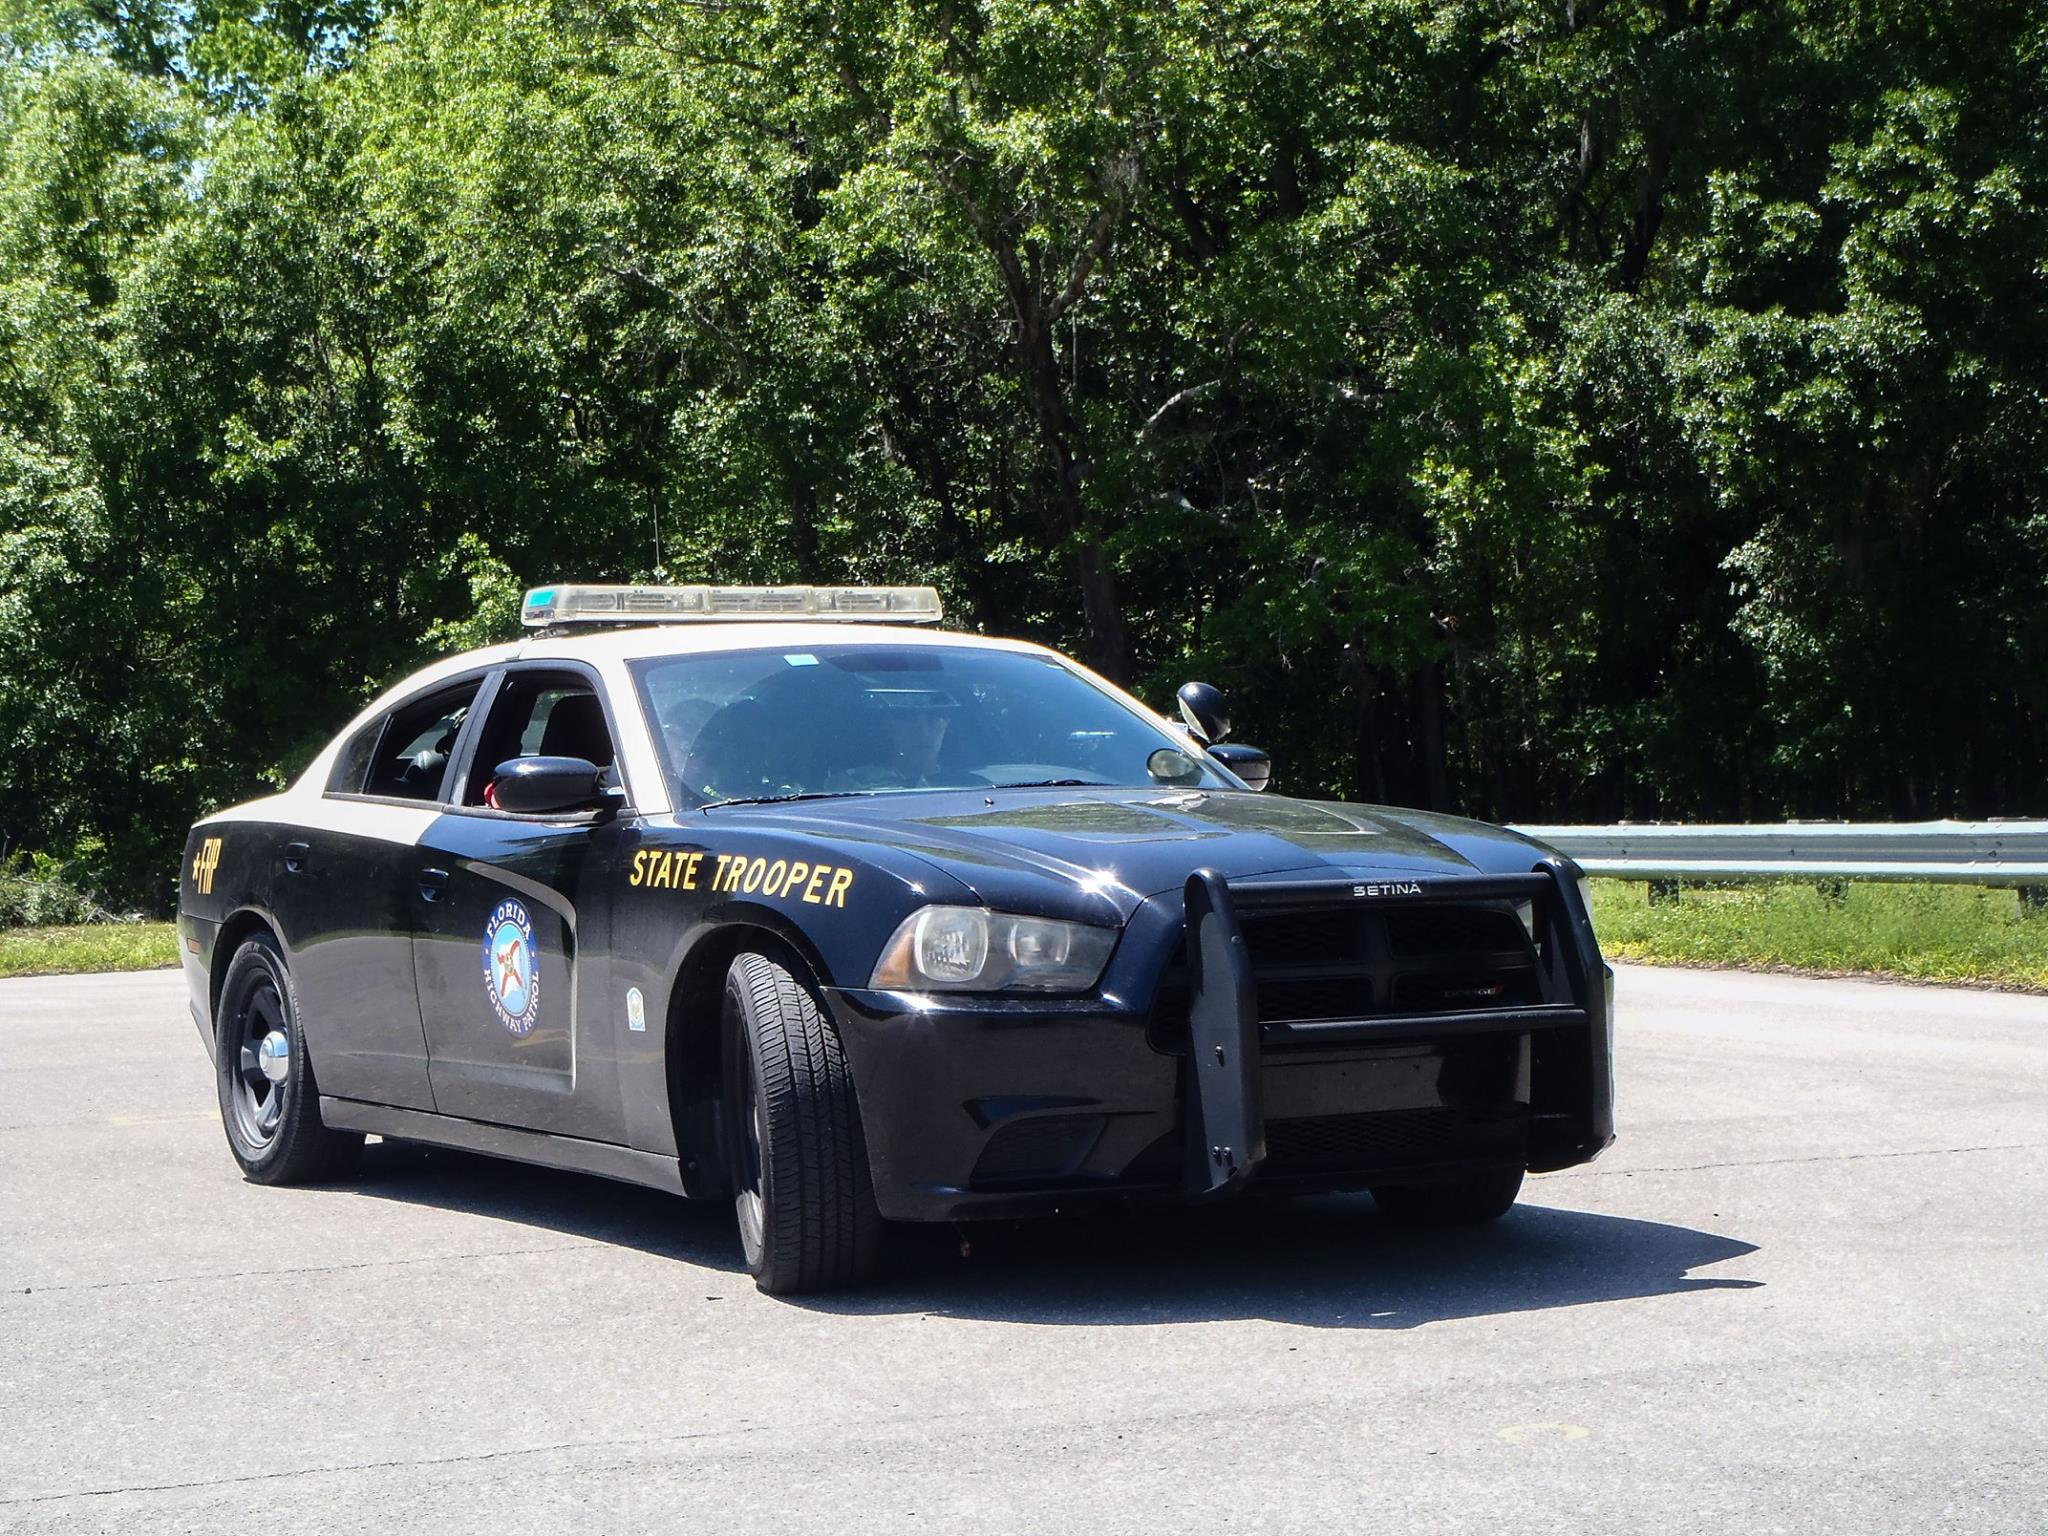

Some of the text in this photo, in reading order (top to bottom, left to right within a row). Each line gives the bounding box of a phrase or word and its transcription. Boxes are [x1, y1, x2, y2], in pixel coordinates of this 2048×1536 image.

[629, 850, 854, 908] STATE TROOPER
[1353, 884, 1422, 897] SETINA
[486, 903, 532, 941] FLORIDA
[484, 969, 540, 1033] HIGHWAY PATROL
